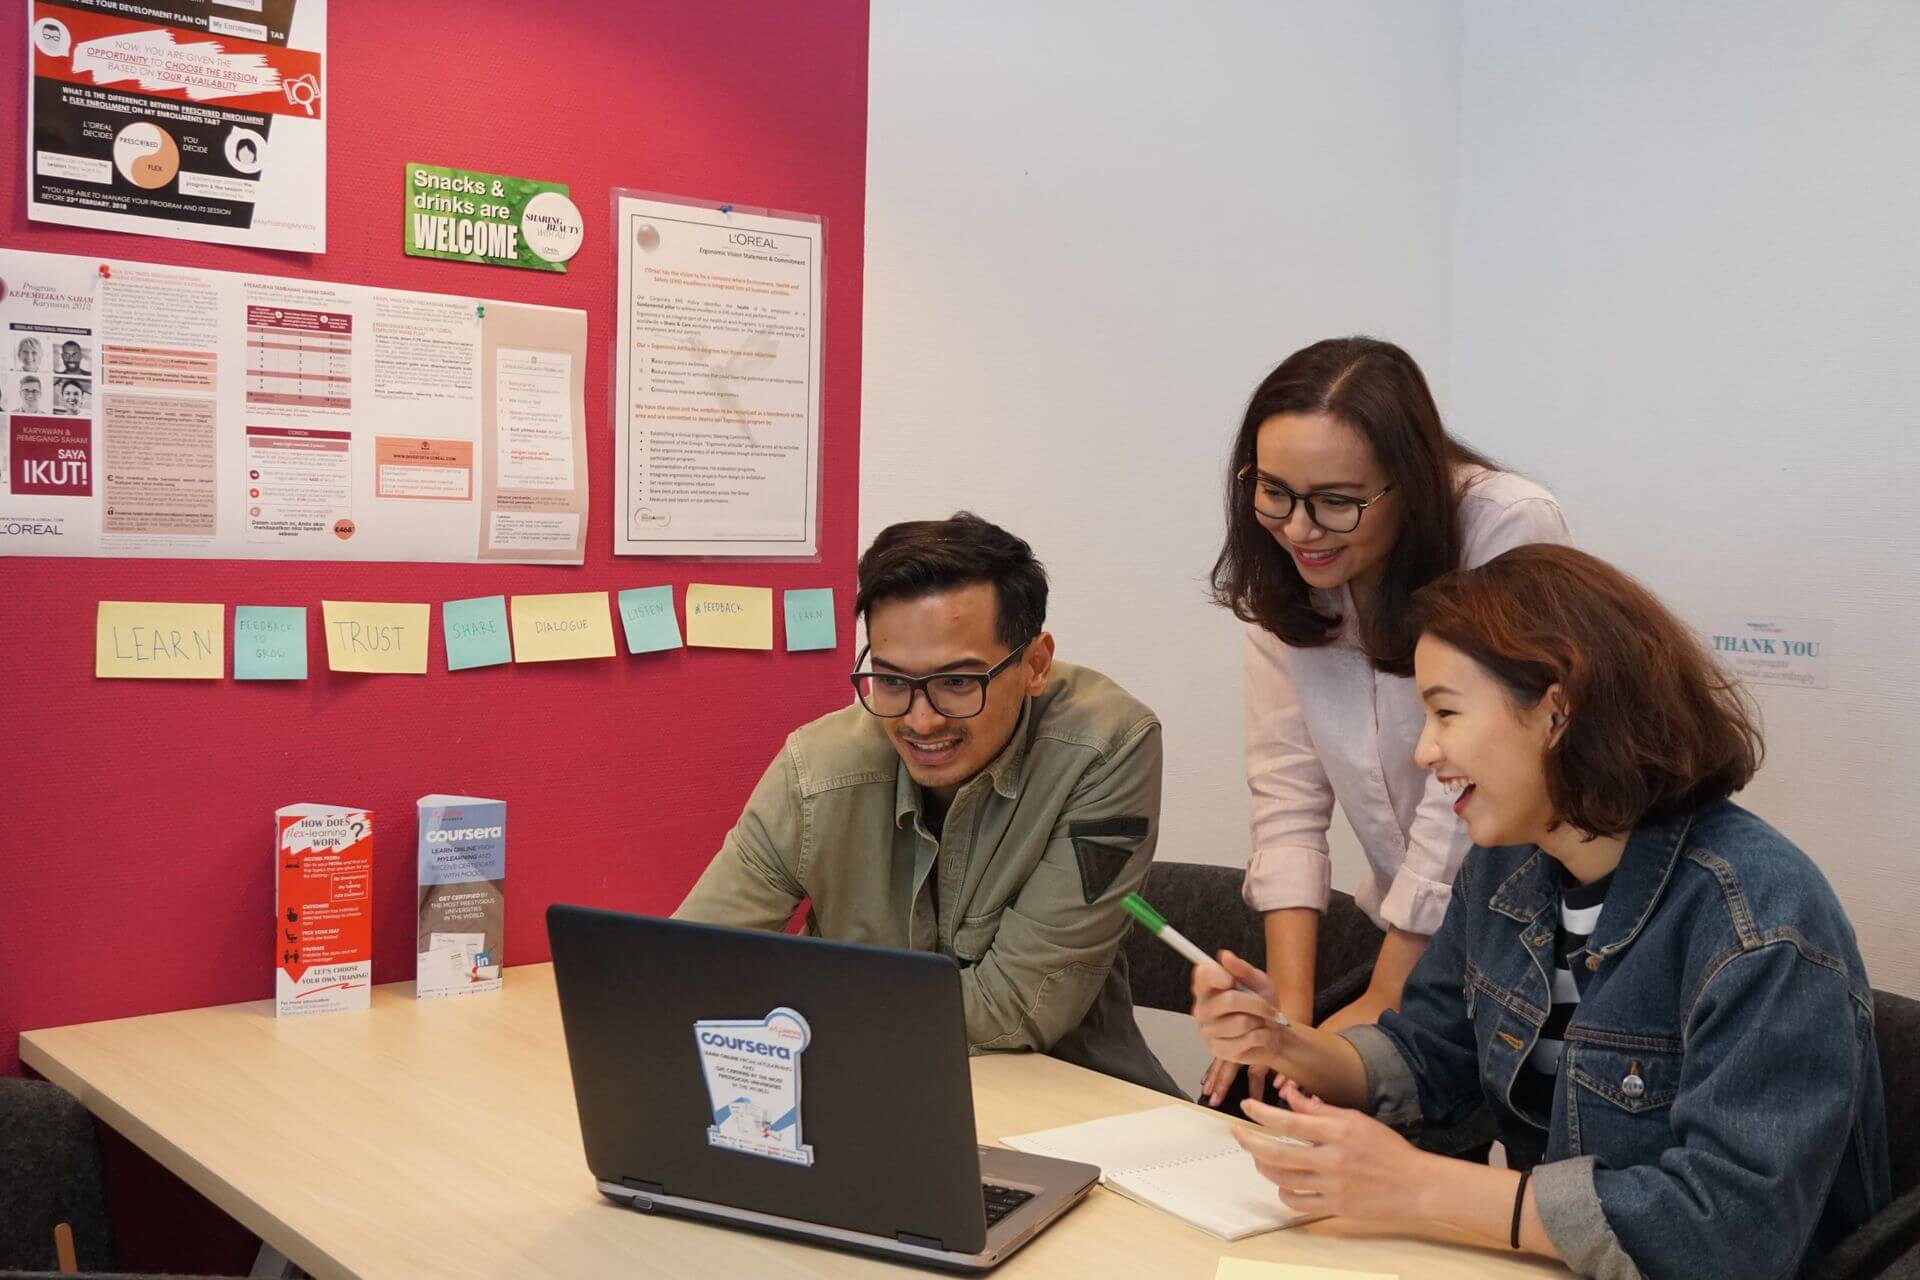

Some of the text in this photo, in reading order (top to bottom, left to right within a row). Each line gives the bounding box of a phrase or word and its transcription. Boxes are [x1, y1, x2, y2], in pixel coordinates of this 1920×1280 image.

[96, 0, 118, 9] YOUR
[119, 3, 173, 19] DEVELOPMENT
[174, 12, 194, 24] PLAN
[194, 17, 208, 26] ON
[270, 31, 285, 39] TAB
[145, 45, 164, 57] YOU
[167, 51, 185, 61] ARE
[187, 53, 217, 64] GIVEN
[217, 57, 232, 67] THE
[86, 47, 258, 84] OPPORTUNITY TO CHOOSE THE SESSION
[108, 61, 136, 74] BASED
[156, 69, 182, 83] YOUR
[62, 86, 82, 97] WHAT
[84, 90, 92, 98] IS
[93, 91, 106, 100] THE
[107, 93, 148, 107] DIFFERENCE
[149, 101, 180, 111] BETWEEN
[222, 111, 265, 126] ENROLLMENT
[86, 99, 132, 114] ENROLLMENT
[131, 107, 143, 115] ON
[82, 128, 114, 141] DECIDES
[182, 135, 199, 144] YOU
[119, 136, 159, 149] PRESCRIBED
[182, 144, 209, 154] DECIDE
[147, 164, 163, 172] FLEX
[413, 169, 505, 198] Snacks &
[42, 192, 65, 203] BEFORE
[63, 187, 75, 195] ARE
[76, 189, 91, 198] ABLE
[92, 191, 101, 199] TO
[102, 193, 131, 204] MANAGE
[132, 197, 149, 205] YOUR
[183, 204, 198, 212] AND
[413, 191, 510, 219] drinks are
[525, 213, 563, 226] SHARING
[413, 213, 519, 260] WELCOME
[546, 224, 581, 236] BEAUTY
[699, 246, 727, 257] Ergonomic
[743, 252, 769, 261] Statement
[774, 256, 806, 266] Commitment
[23, 282, 57, 292] Program
[67, 295, 94, 304] SAHAM
[23, 426, 64, 436] KARYAWAN
[16, 434, 59, 443] PEMEGANG
[58, 449, 87, 460] SAYA
[24, 459, 88, 485] IKUT!
[626, 601, 665, 622] LISTEN
[703, 601, 744, 614] FEEDBACK
[240, 619, 294, 632] FEEDBACK
[452, 618, 497, 639] SHARE
[535, 618, 589, 634] DIALOGUE
[113, 624, 213, 662] LEARN
[253, 634, 267, 644] TO
[333, 620, 405, 653] TRUST
[1712, 635, 1821, 657] THANK YOU
[256, 648, 286, 659] GROW
[302, 818, 351, 828] HOW DOES
[286, 822, 364, 842] flex-learning ?
[426, 821, 502, 843] coursera
[313, 838, 341, 846] WORK
[453, 845, 477, 853] ONLINE
[437, 854, 478, 862] MYLEARNING
[438, 895, 451, 903] GET
[451, 892, 480, 901] CERTIFIED
[443, 900, 460, 908] MOST
[451, 913, 463, 921] THE
[463, 911, 485, 920] WORLD
[314, 965, 358, 975] LET'S CHOOSE
[303, 977, 322, 985] YOUR
[321, 976, 338, 984] OWN
[701, 1031, 791, 1061] coursera
